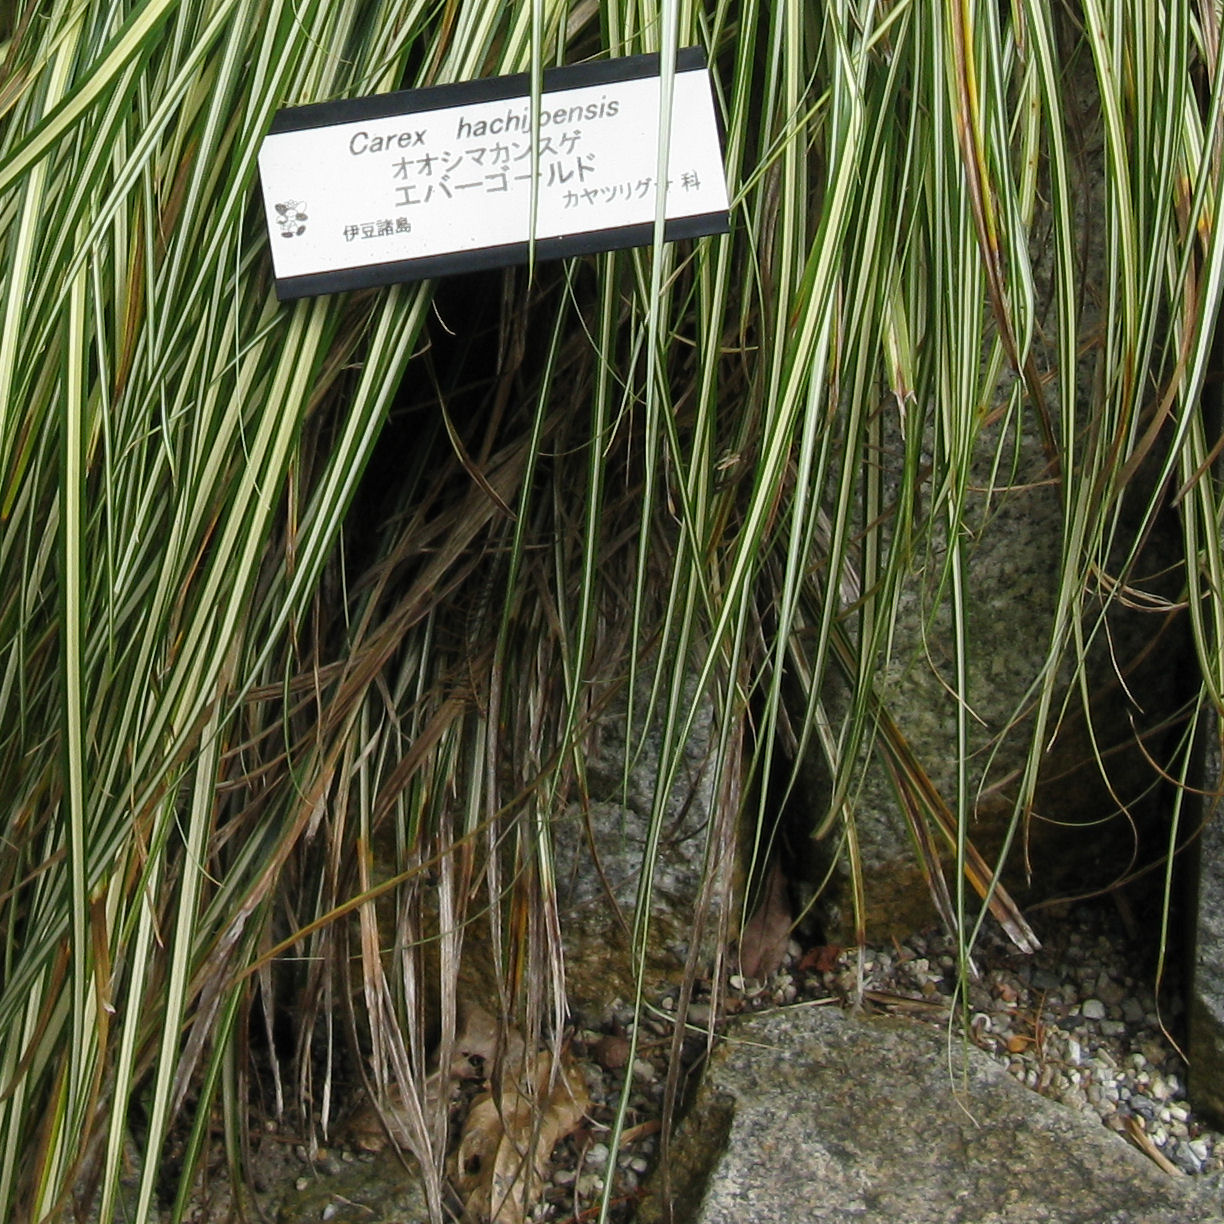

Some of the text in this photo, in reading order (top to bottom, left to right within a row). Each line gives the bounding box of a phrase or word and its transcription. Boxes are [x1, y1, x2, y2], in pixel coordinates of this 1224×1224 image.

[349, 129, 427, 156] Carex
[395, 153, 596, 207] エバーゴールド
[343, 217, 412, 242] 伊豆諸島
